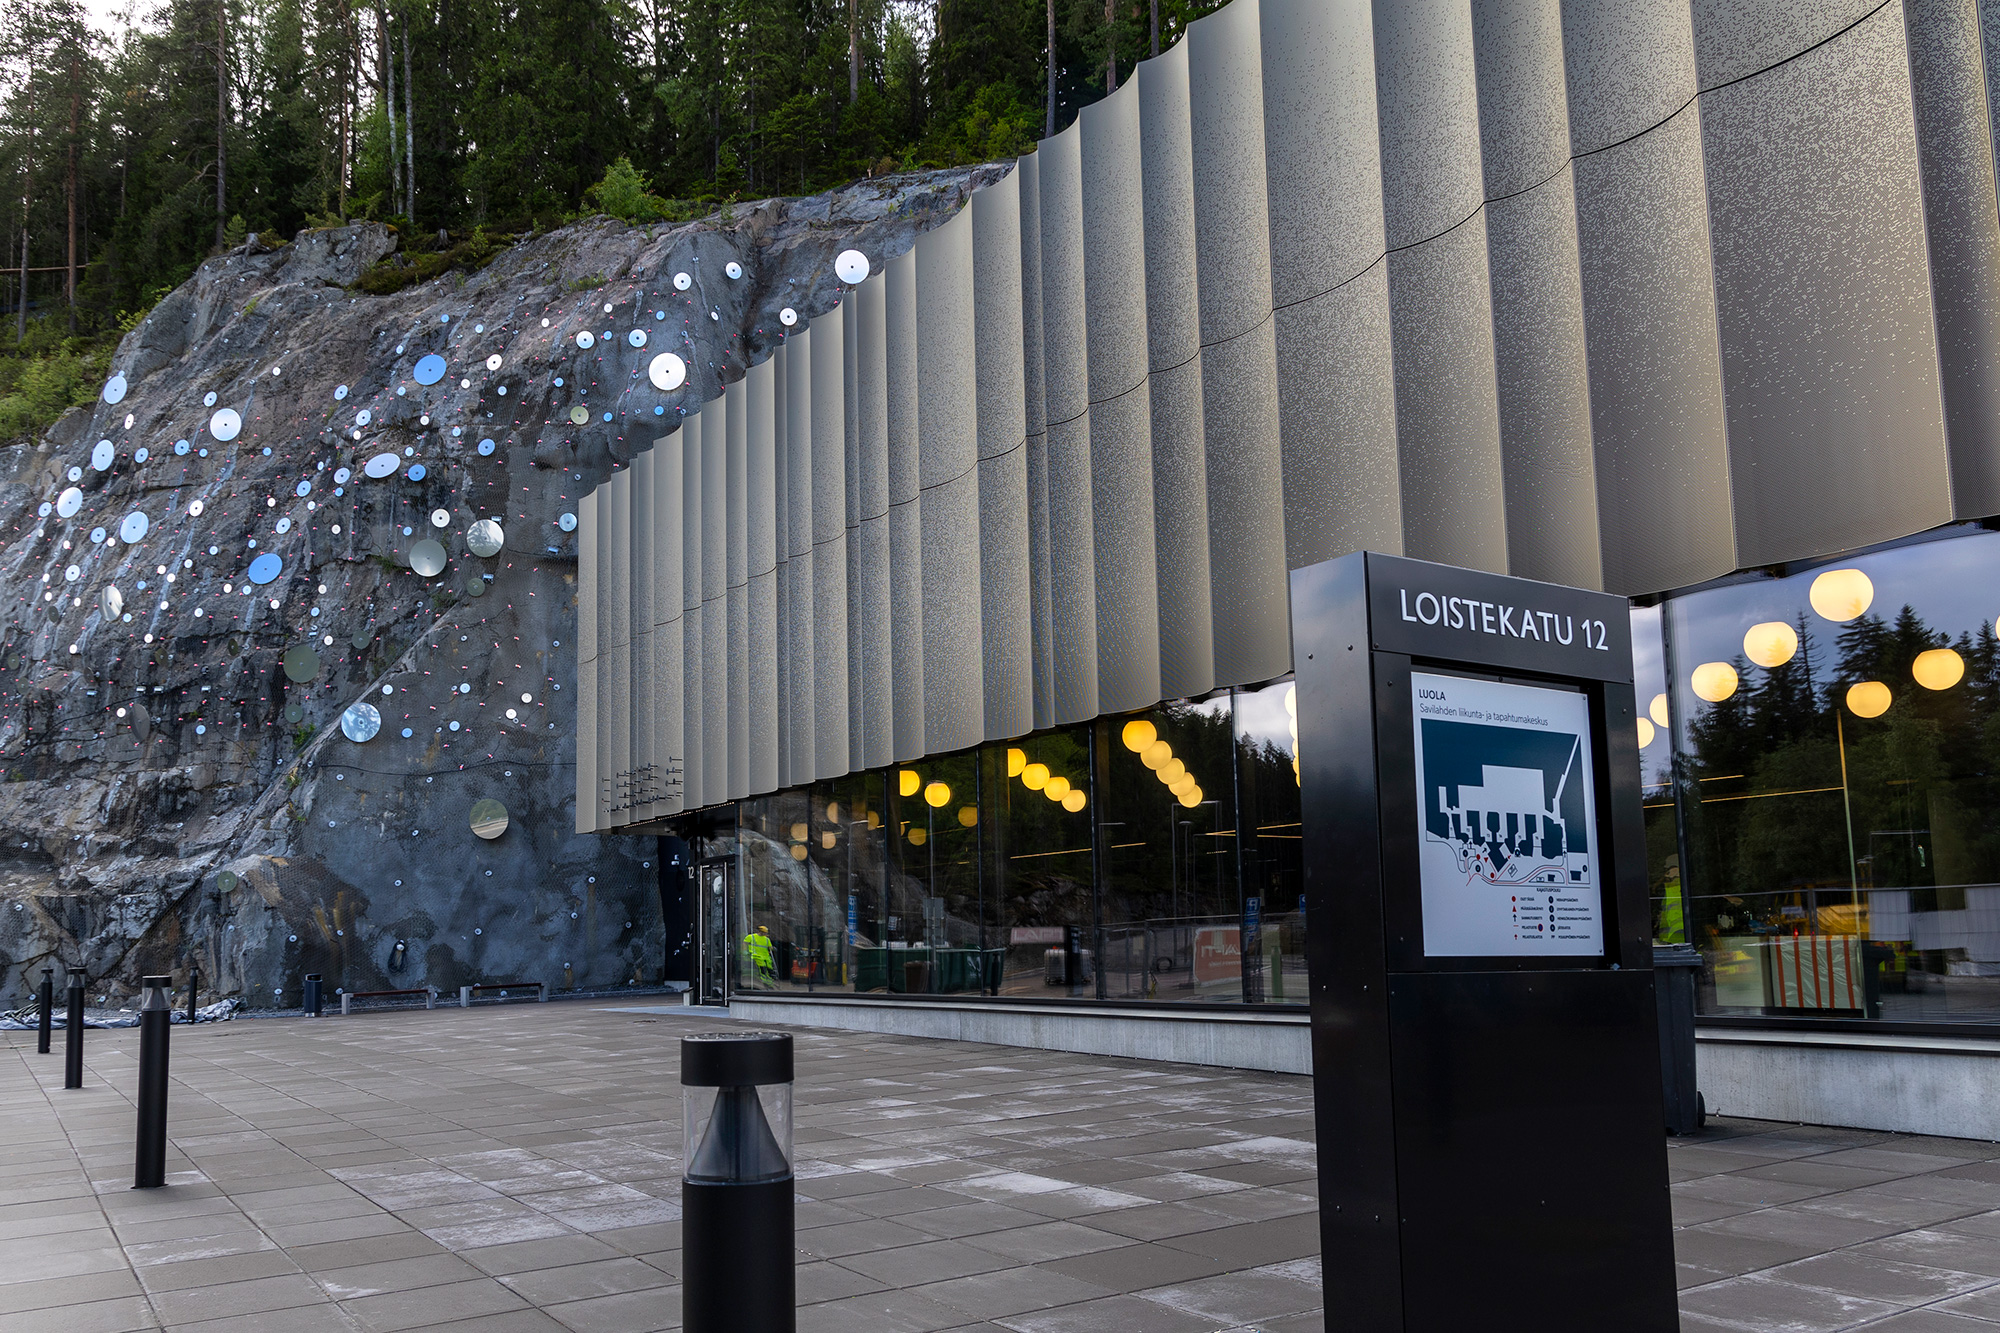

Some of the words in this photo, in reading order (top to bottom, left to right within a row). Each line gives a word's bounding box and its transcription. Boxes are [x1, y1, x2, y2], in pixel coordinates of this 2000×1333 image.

[1400, 589, 1573, 645] LOISTEKATU
[1580, 619, 1609, 651] 12
[1419, 689, 1446, 701] LUOLA
[1419, 703, 1457, 716] Savilahden
[1458, 707, 1484, 718] liikunta-
[1485, 711, 1492, 721] ja
[1493, 713, 1548, 726] tapahtumakeskus
[687, 866, 695, 879] 12
